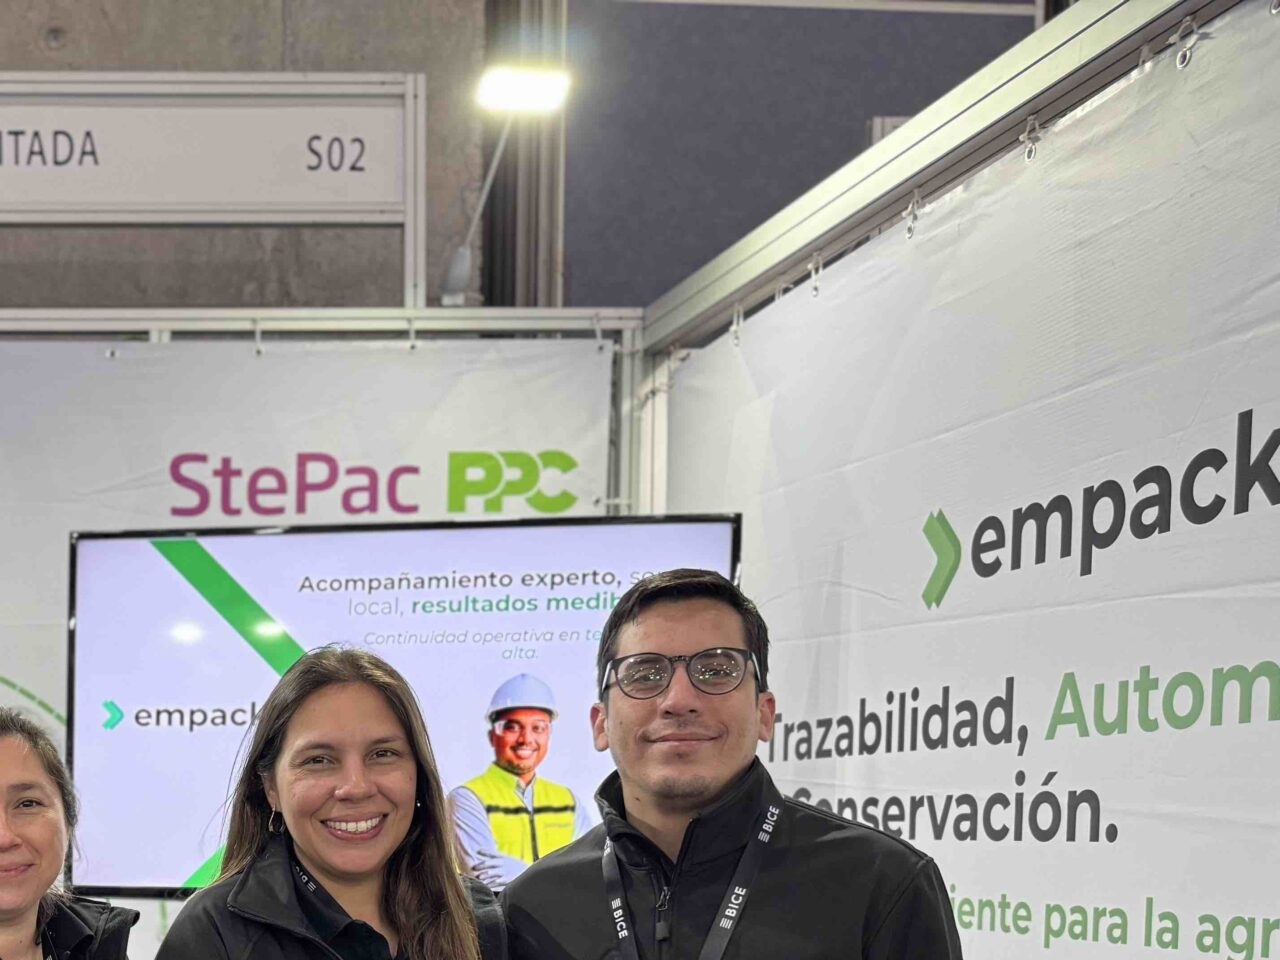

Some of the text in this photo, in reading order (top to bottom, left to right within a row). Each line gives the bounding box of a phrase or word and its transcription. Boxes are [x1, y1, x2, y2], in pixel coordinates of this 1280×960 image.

[304, 136, 366, 174] S02
[170, 449, 579, 518] StePac PPC
[970, 409, 1280, 578] empack
[298, 570, 513, 594] Acompañamiento
[520, 569, 622, 590] experto,
[348, 599, 404, 617] local,
[412, 595, 538, 615] resultados
[364, 630, 468, 646] Continuidad
[472, 631, 554, 646] operativa
[558, 631, 580, 642] en
[502, 647, 538, 660] alta.
[768, 660, 1280, 763] Trazabilidad, Autom
[762, 804, 780, 834] BICE
[793, 769, 1118, 844] nservación.
[724, 885, 747, 918] BICE
[613, 908, 628, 939] BICE
[1043, 903, 1128, 949] para
[1144, 897, 1179, 950] la
